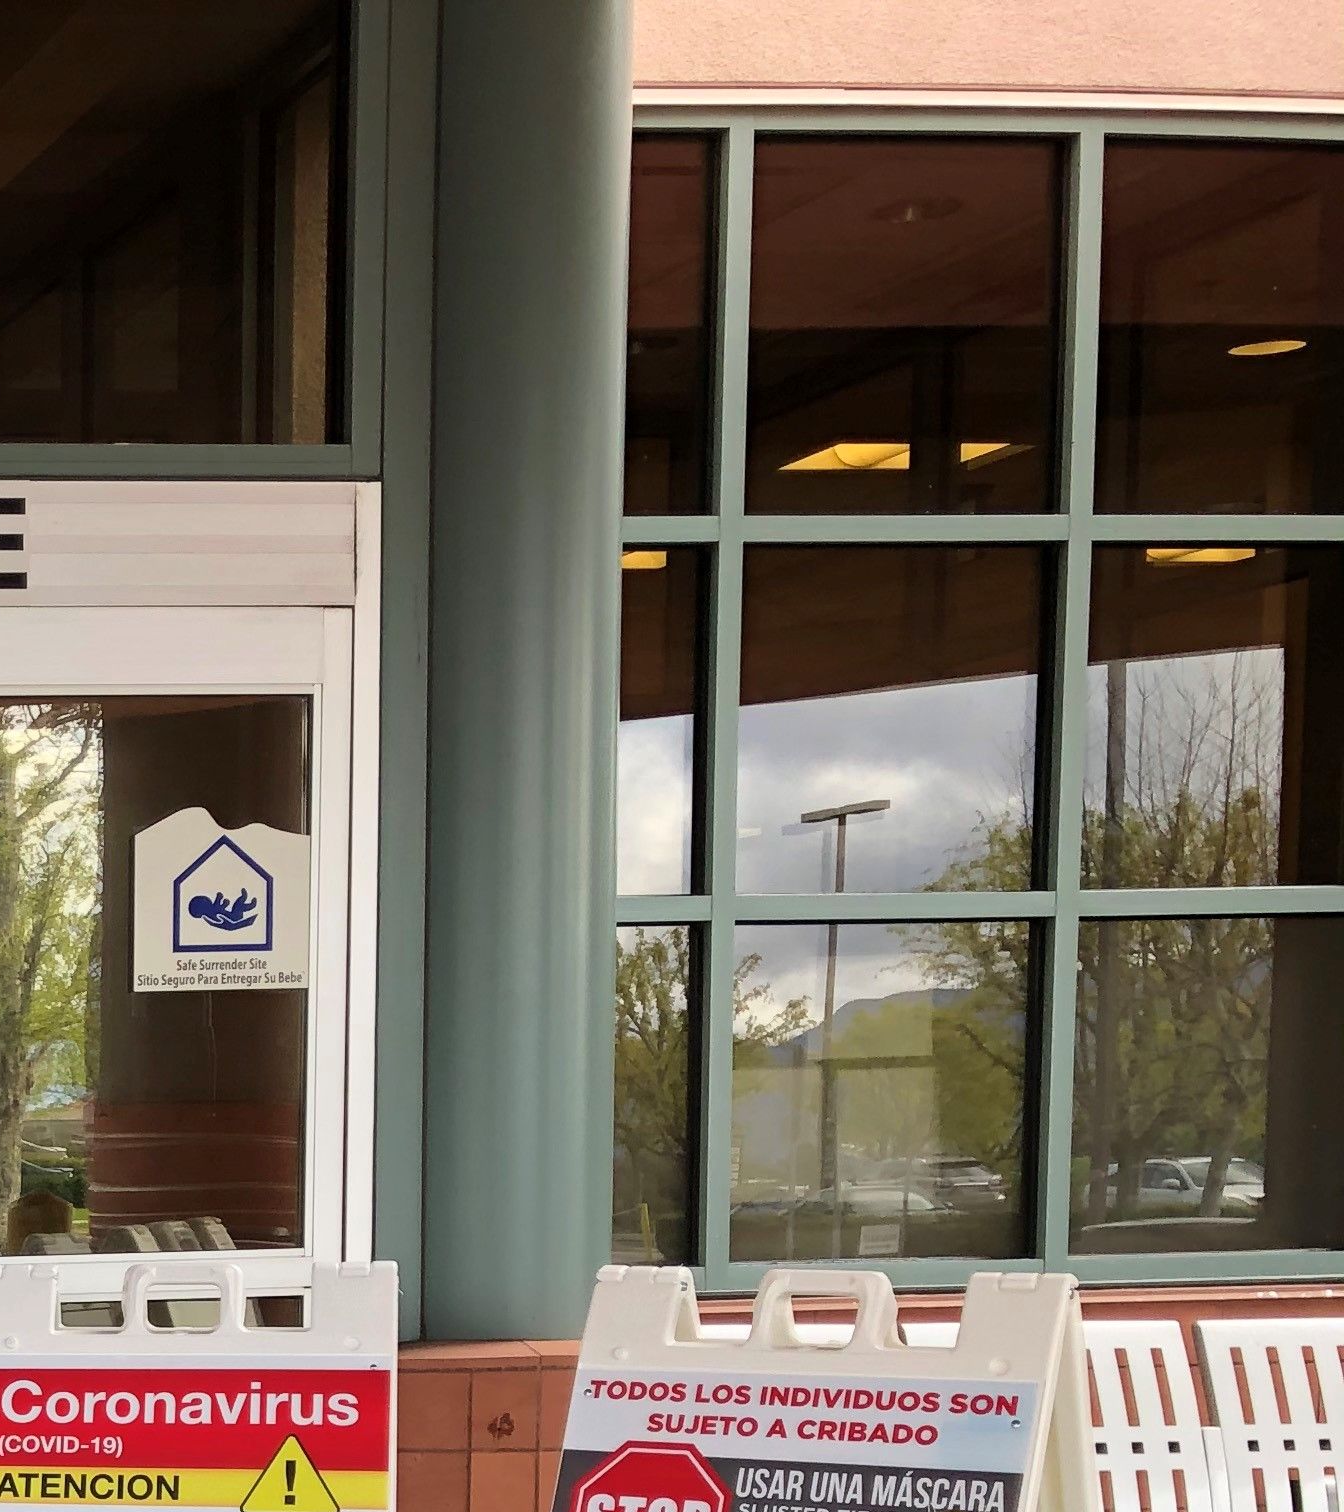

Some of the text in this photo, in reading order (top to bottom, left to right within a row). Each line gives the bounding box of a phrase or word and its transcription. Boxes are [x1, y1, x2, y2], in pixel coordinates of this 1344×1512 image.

[137, 974, 159, 986] Sitio
[161, 974, 195, 988] Seguro
[197, 974, 218, 985] Para
[221, 973, 262, 986] Entregar
[264, 972, 276, 984] Su
[176, 957, 267, 970] Safe Surrender Site
[1, 1380, 358, 1425] Coronavirus
[591, 1380, 1018, 1415] TODOS LOS INDIVIDUOS SON
[647, 1413, 937, 1445] SUJETO A CRIBADO
[736, 1468, 1003, 1512] USAR UNA MÁSCARA
